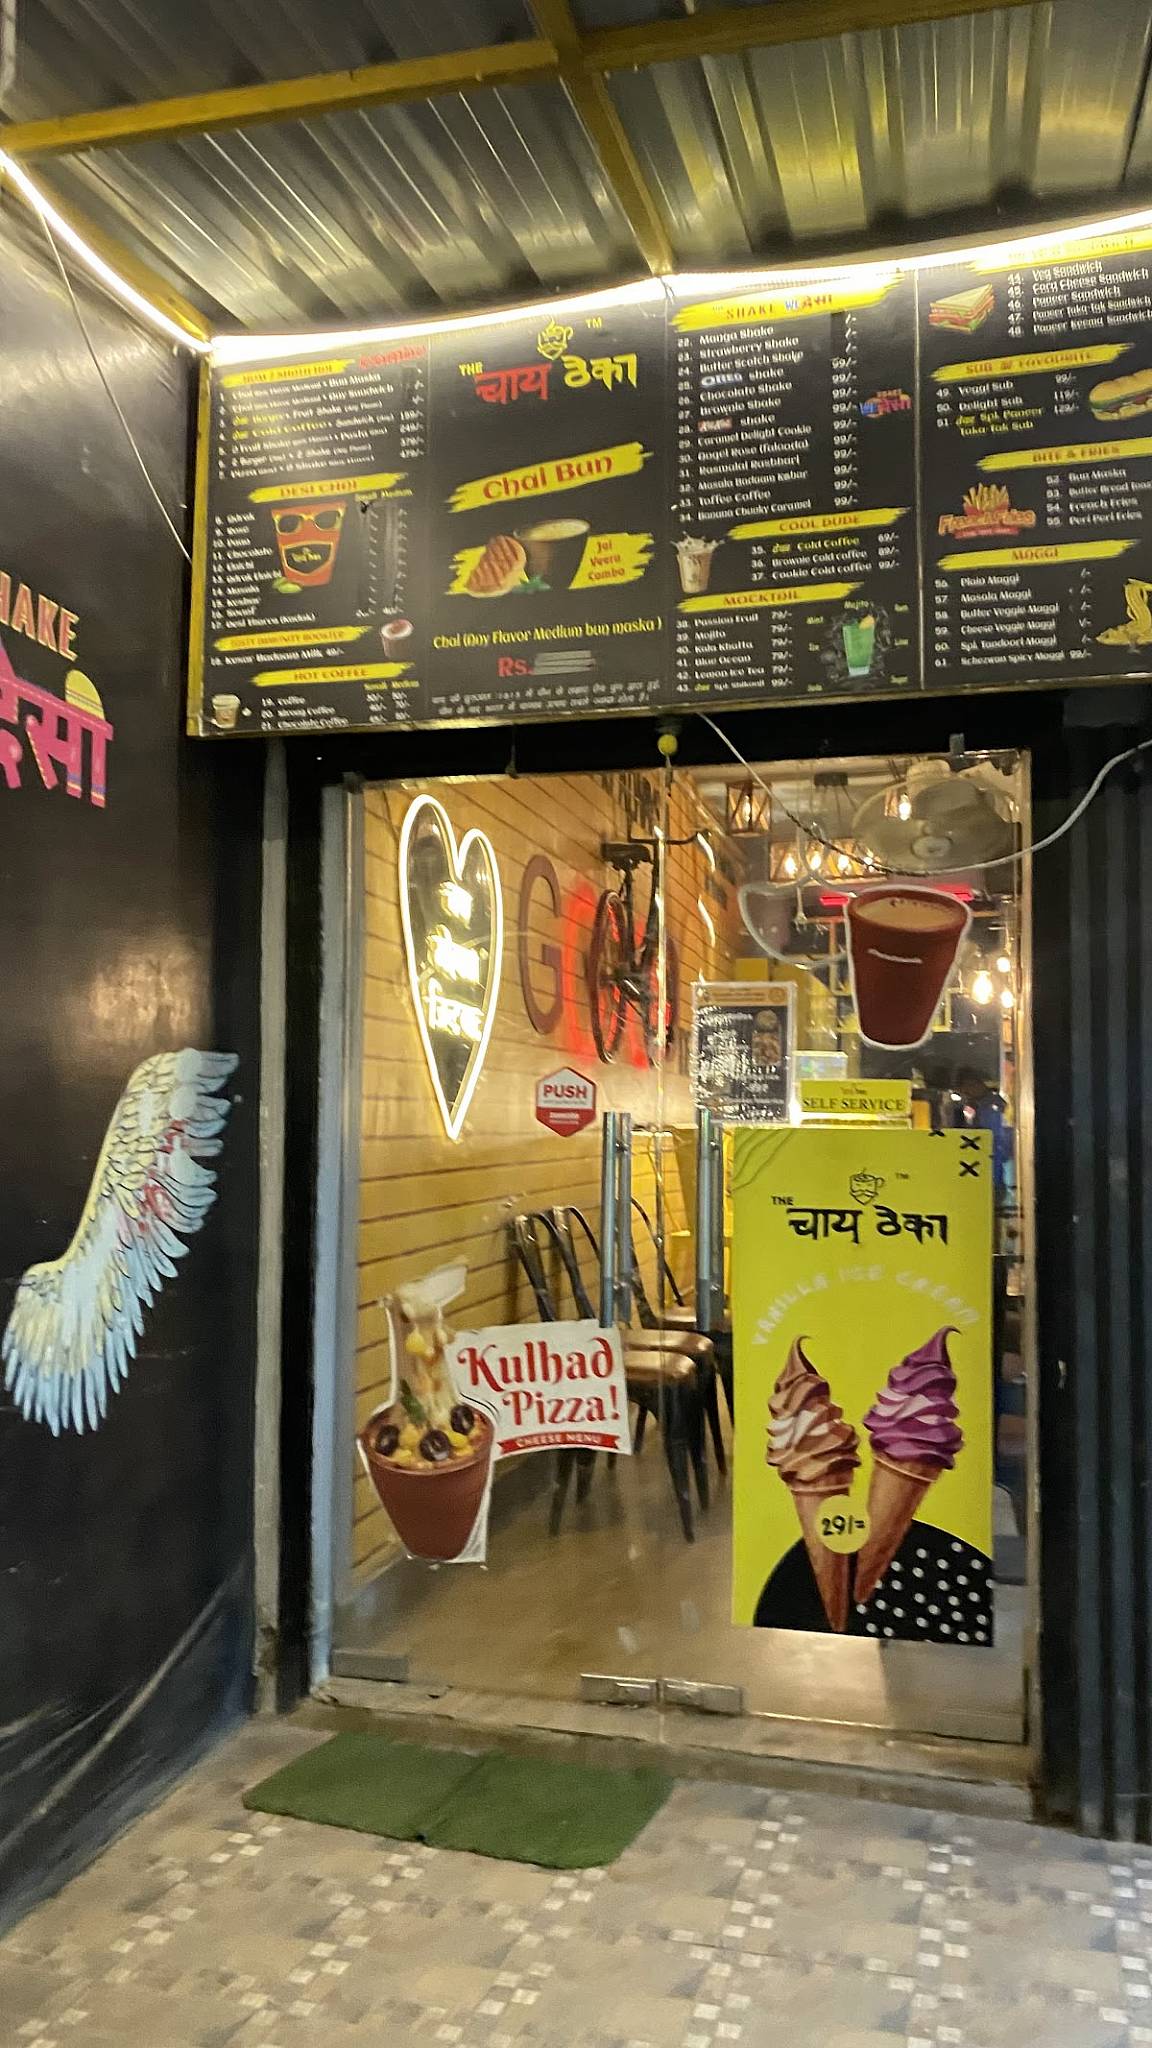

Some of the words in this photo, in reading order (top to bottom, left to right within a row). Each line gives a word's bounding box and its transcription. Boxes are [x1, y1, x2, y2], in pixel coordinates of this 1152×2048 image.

[459, 361, 484, 376] THE
[475, 363, 552, 404] चाय
[561, 352, 638, 391] ठेका
[555, 456, 612, 482] Bun
[544, 1085, 587, 1098] PUSH
[802, 1097, 838, 1109] SELF
[841, 1098, 906, 1111] SERVICE
[771, 1196, 794, 1206] THE
[786, 1208, 863, 1245] चाय
[873, 1205, 948, 1245] ठेका
[457, 1336, 614, 1392] Kulhad
[502, 1384, 620, 1426] Pizza!
